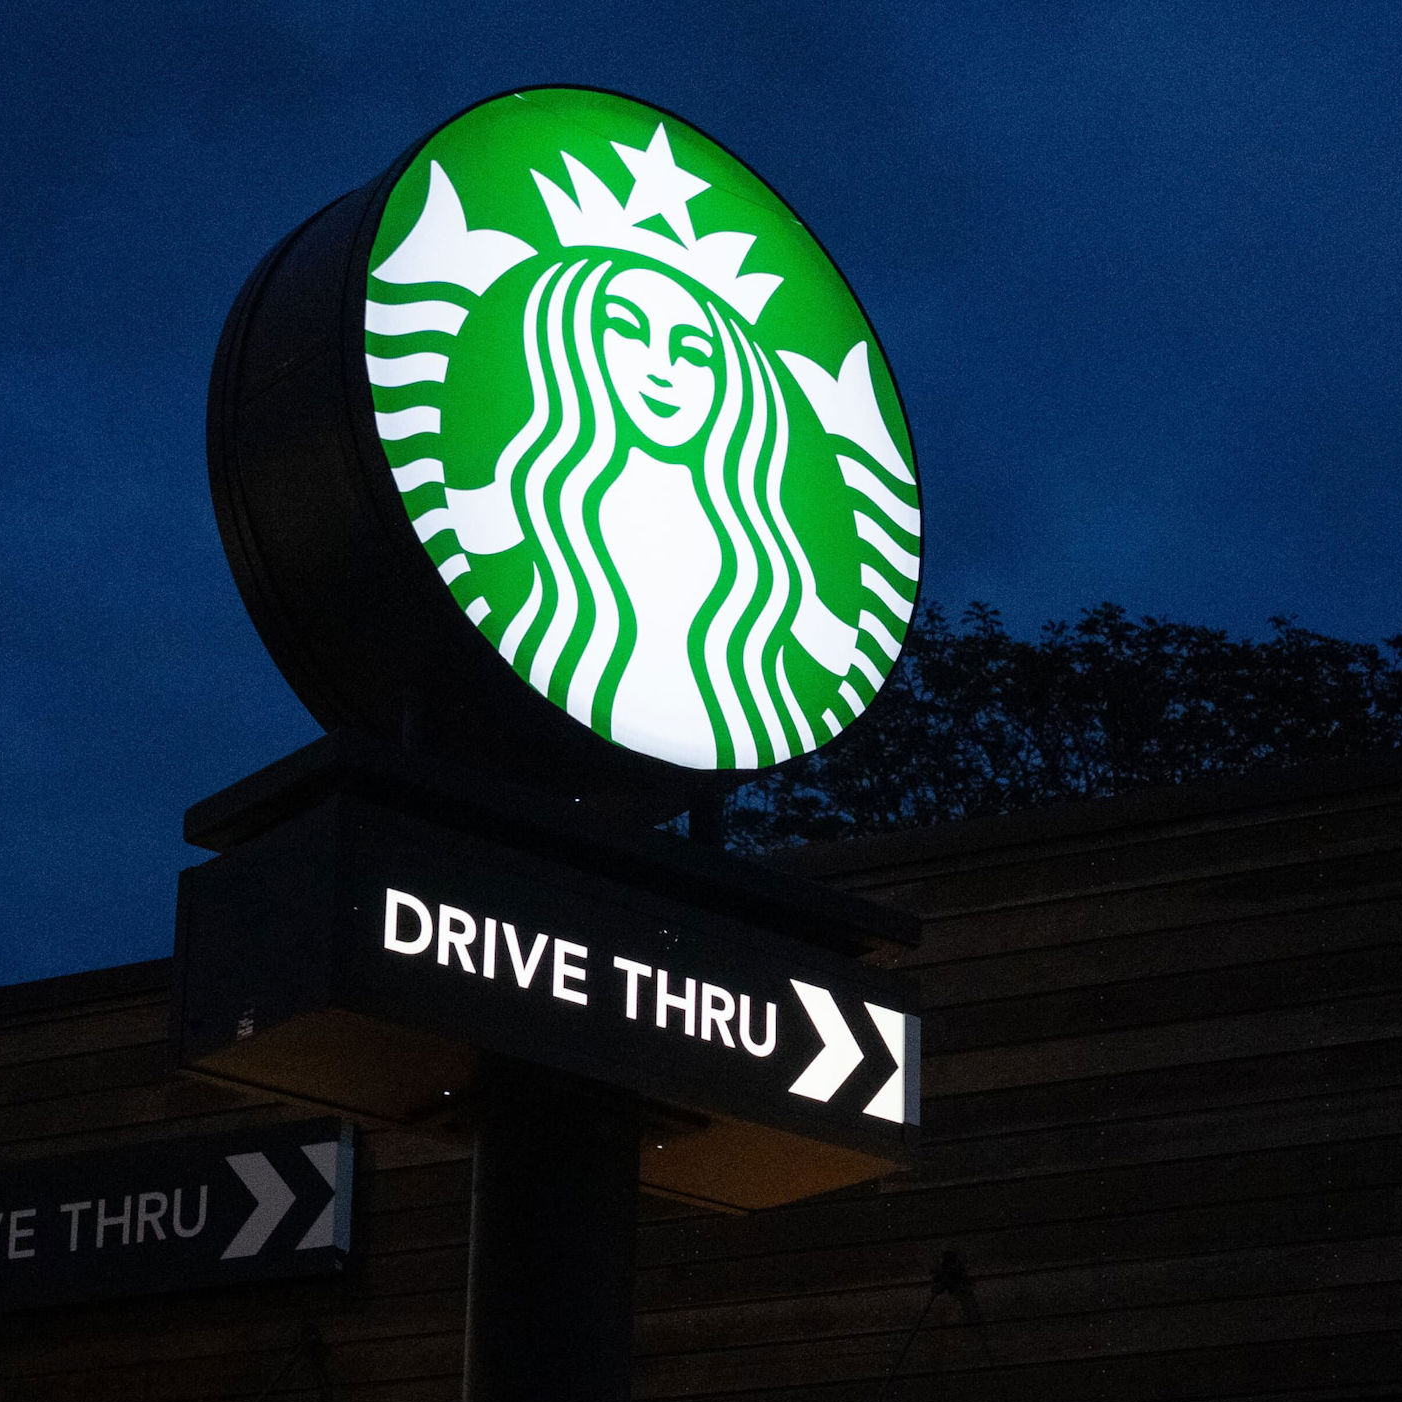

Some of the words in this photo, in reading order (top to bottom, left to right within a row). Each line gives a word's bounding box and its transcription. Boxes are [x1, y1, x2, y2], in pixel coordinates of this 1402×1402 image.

[383, 887, 588, 1006] DRIVE
[613, 955, 777, 1058] THRU
[59, 1184, 210, 1251] THRU
